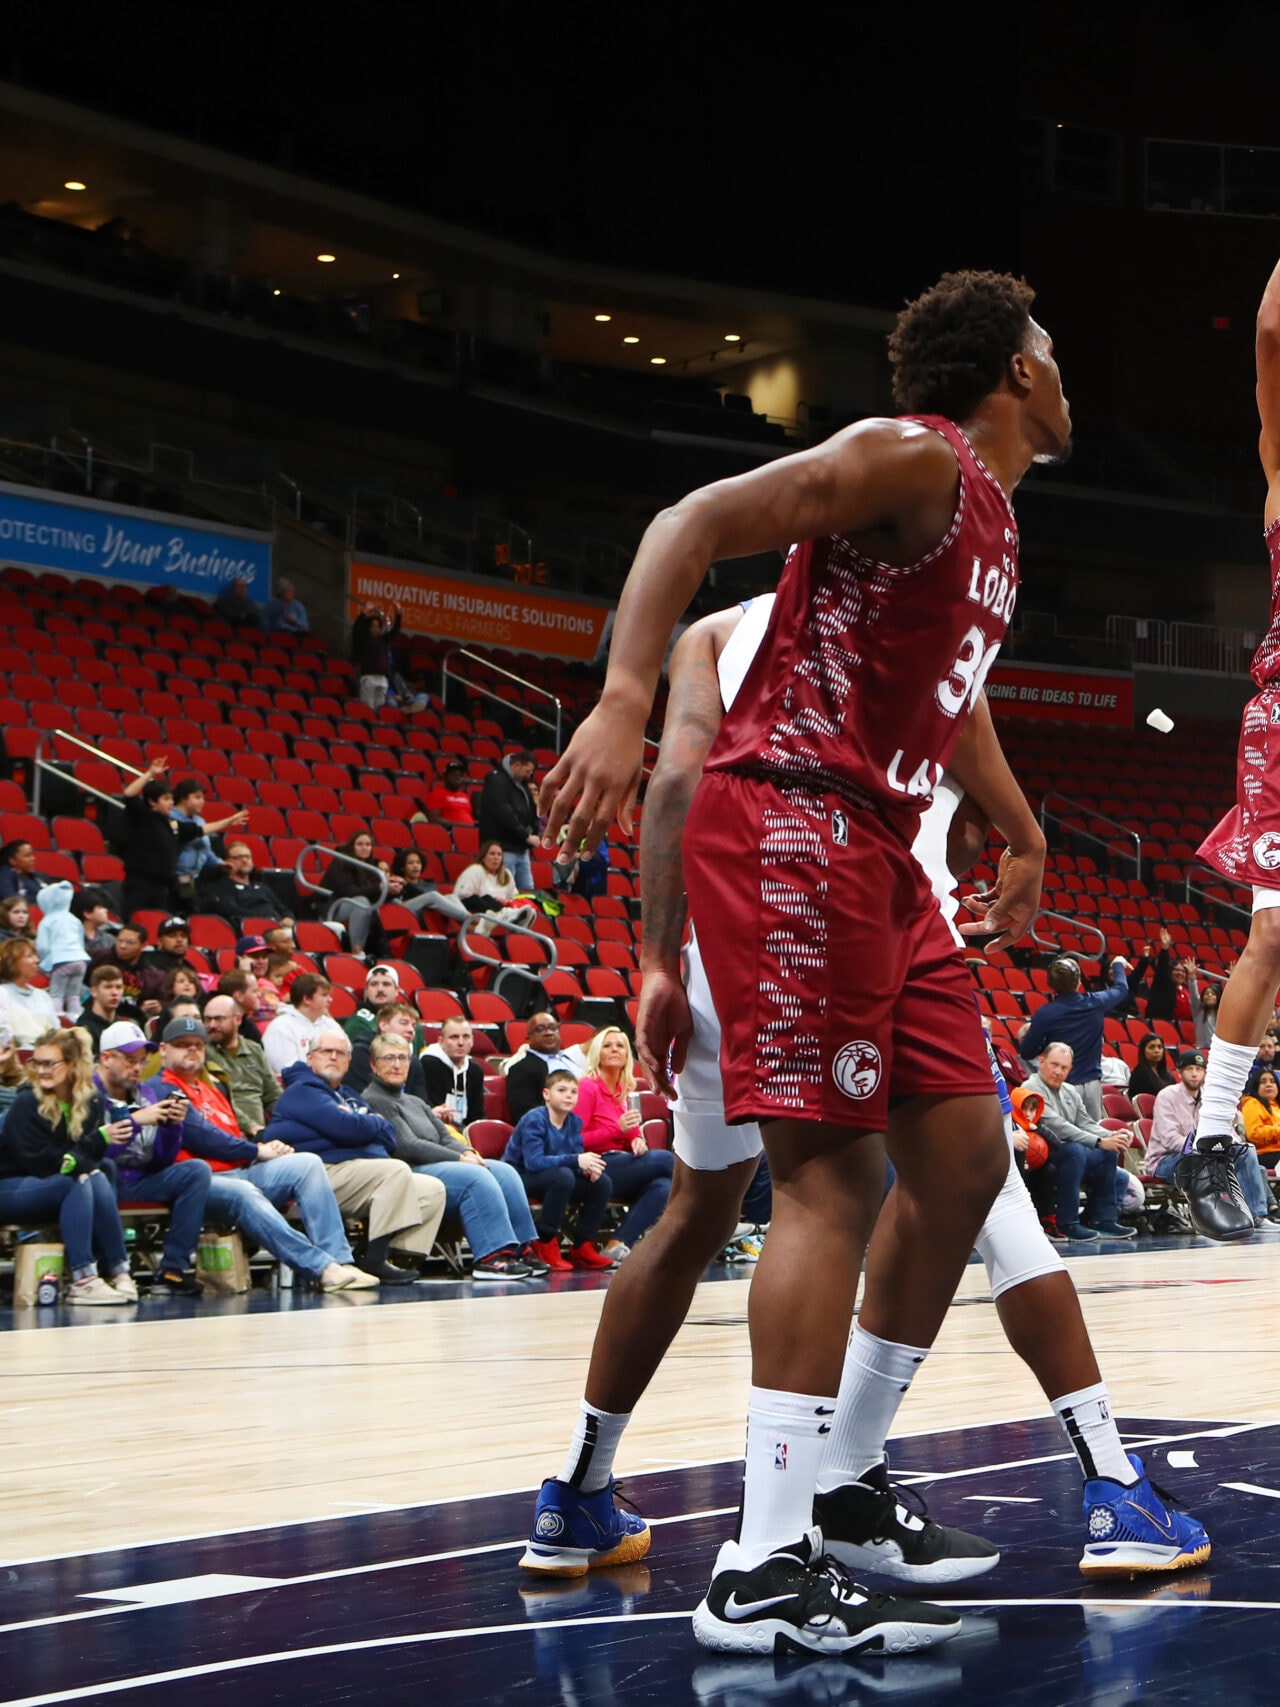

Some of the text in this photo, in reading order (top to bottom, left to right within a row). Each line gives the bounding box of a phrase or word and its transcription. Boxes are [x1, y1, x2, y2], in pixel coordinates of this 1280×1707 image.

[101, 524, 162, 568] Your
[164, 537, 257, 583] Business
[357, 578, 440, 608] INNOVATIVE
[443, 594, 519, 621] INSURANCE
[522, 608, 595, 636] SOLUTIONS
[455, 615, 512, 641] FARMERS
[1019, 687, 1040, 701] BIG
[1041, 689, 1074, 705] IDEAS
[1077, 692, 1092, 706] TO
[1094, 694, 1118, 708] LIFE
